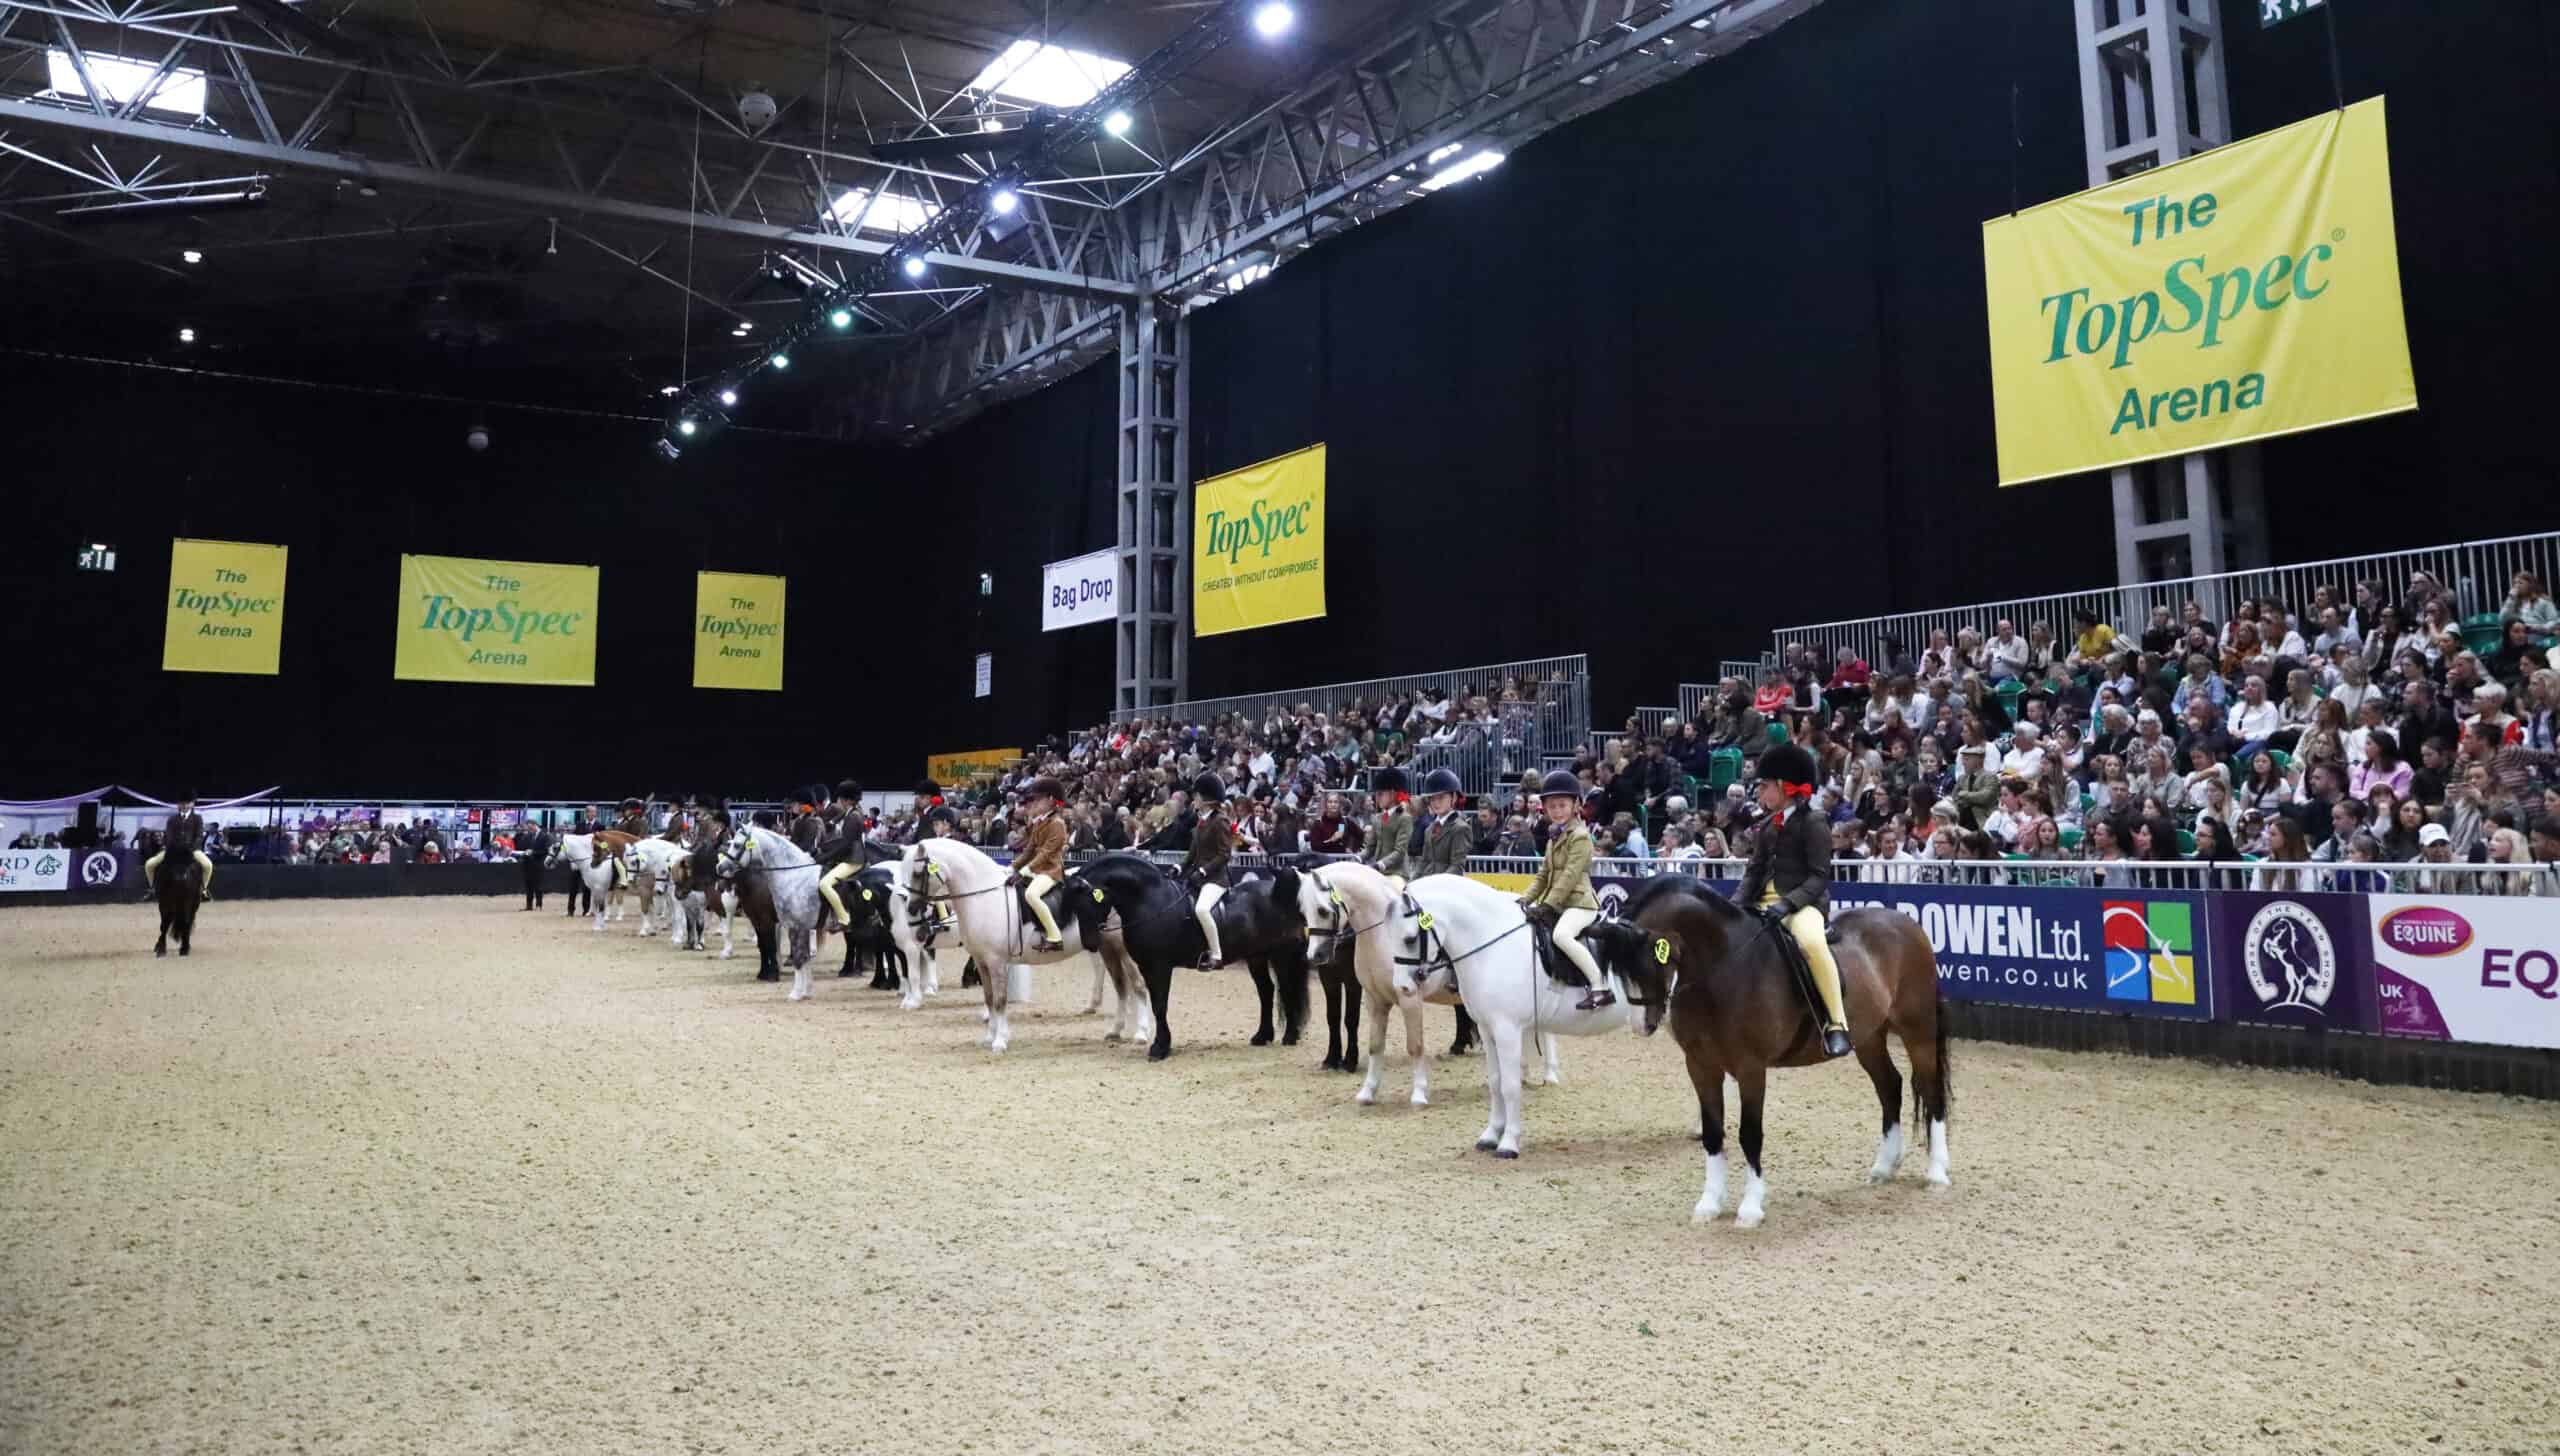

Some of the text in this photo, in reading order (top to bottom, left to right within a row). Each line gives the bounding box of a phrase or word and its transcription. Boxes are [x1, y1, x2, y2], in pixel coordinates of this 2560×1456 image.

[2123, 192, 2217, 247] The
[2041, 243, 2333, 370] TopSpec
[2110, 371, 2265, 435] Arena
[1206, 499, 1311, 564] TopSpec
[215, 568, 247, 583] The
[486, 575, 520, 592] The
[1203, 559, 1318, 592] CREATED WITHOUT COMPROMISE
[175, 588, 275, 617] TopSpec
[729, 597, 755, 610] The
[1053, 578, 1112, 611] Bag Drop
[198, 623, 252, 638] Arena
[420, 595, 583, 644] TopSpec
[701, 615, 777, 640] TopSpec
[468, 649, 528, 665] Arena
[719, 645, 761, 658] Arena
[2035, 919, 2090, 961] Ltd.
[2393, 924, 2457, 945] EQUINE
[1936, 963, 2089, 990] wen.co.uk
[2481, 948, 2559, 1000] EQ
[2380, 983, 2403, 998] UK
